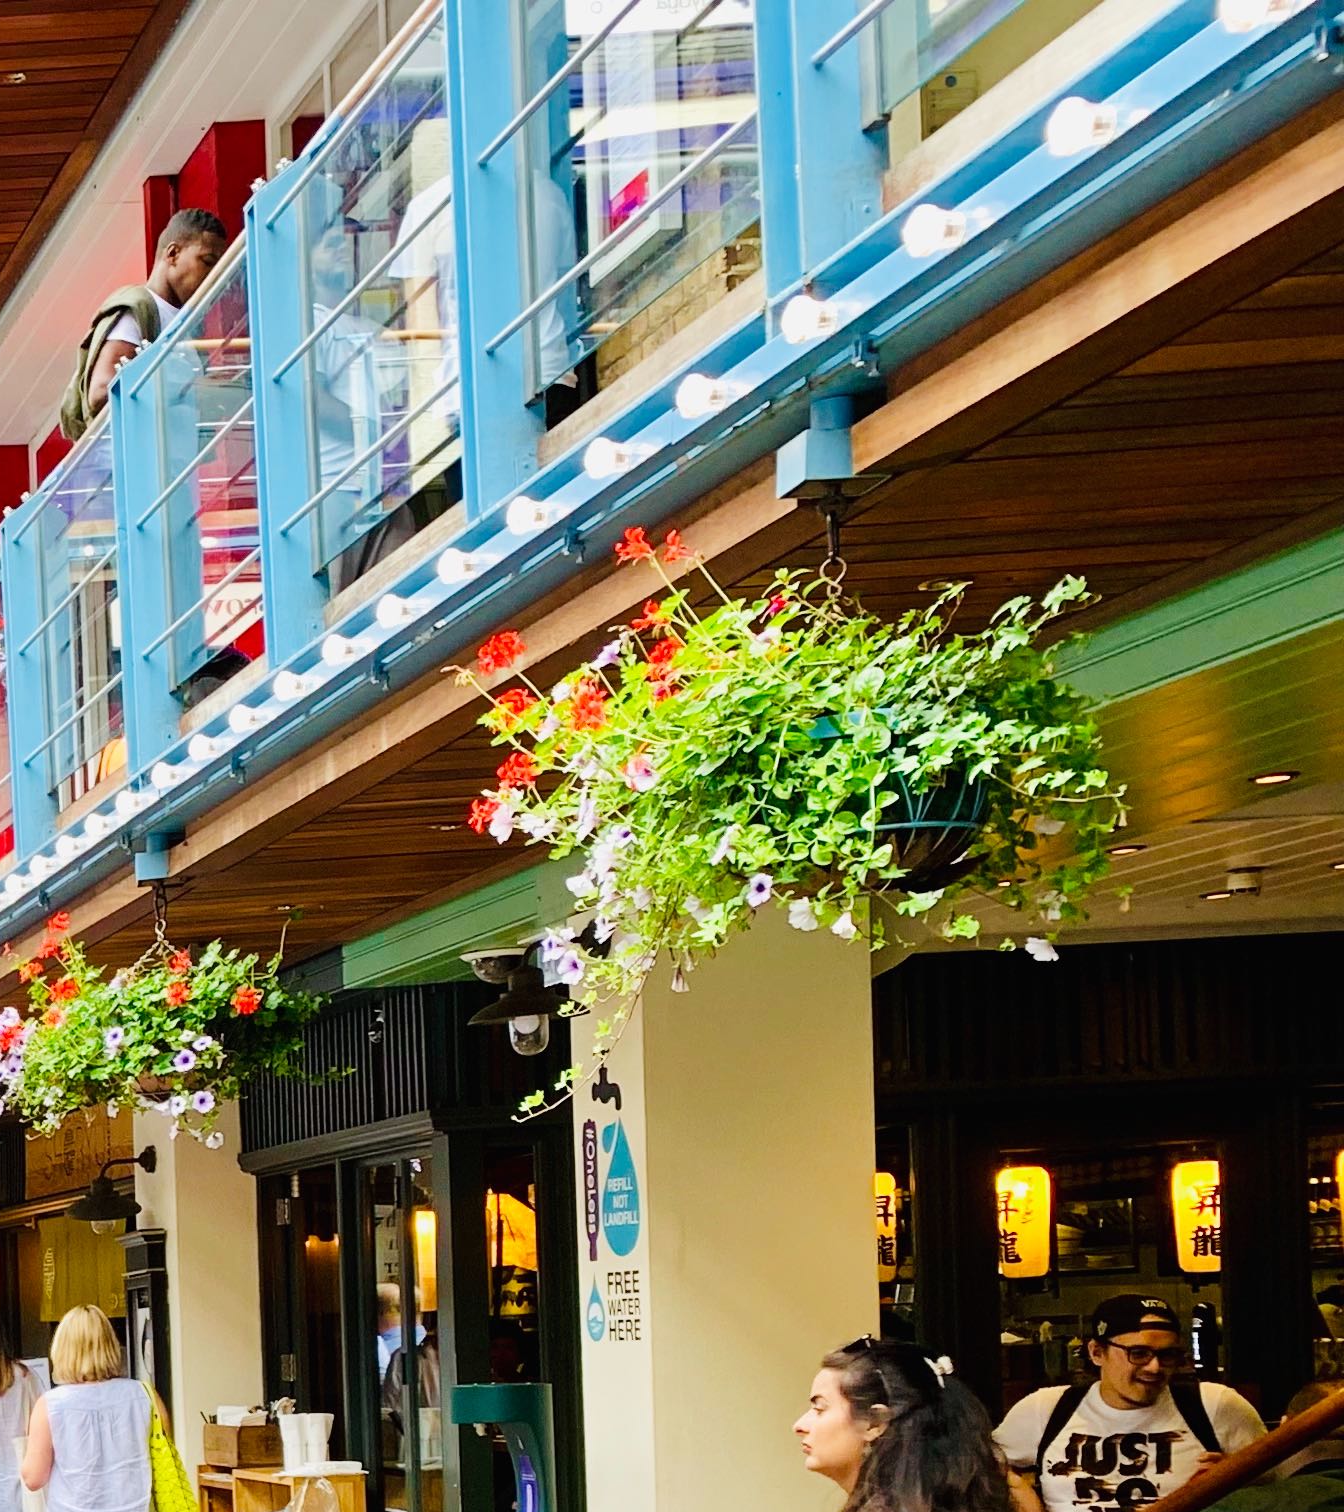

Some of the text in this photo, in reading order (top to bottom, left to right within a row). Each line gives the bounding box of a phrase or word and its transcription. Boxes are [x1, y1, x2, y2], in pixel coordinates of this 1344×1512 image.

[607, 1177, 633, 1192] REFILL
[613, 1194, 629, 1209] NOT
[604, 1210, 639, 1227] LANDFILL
[607, 1270, 640, 1294] FREE
[607, 1297, 641, 1316] WATER
[609, 1319, 642, 1341] HERE
[1047, 1430, 1188, 1477] JUST
[1072, 1477, 1161, 1510] DO
